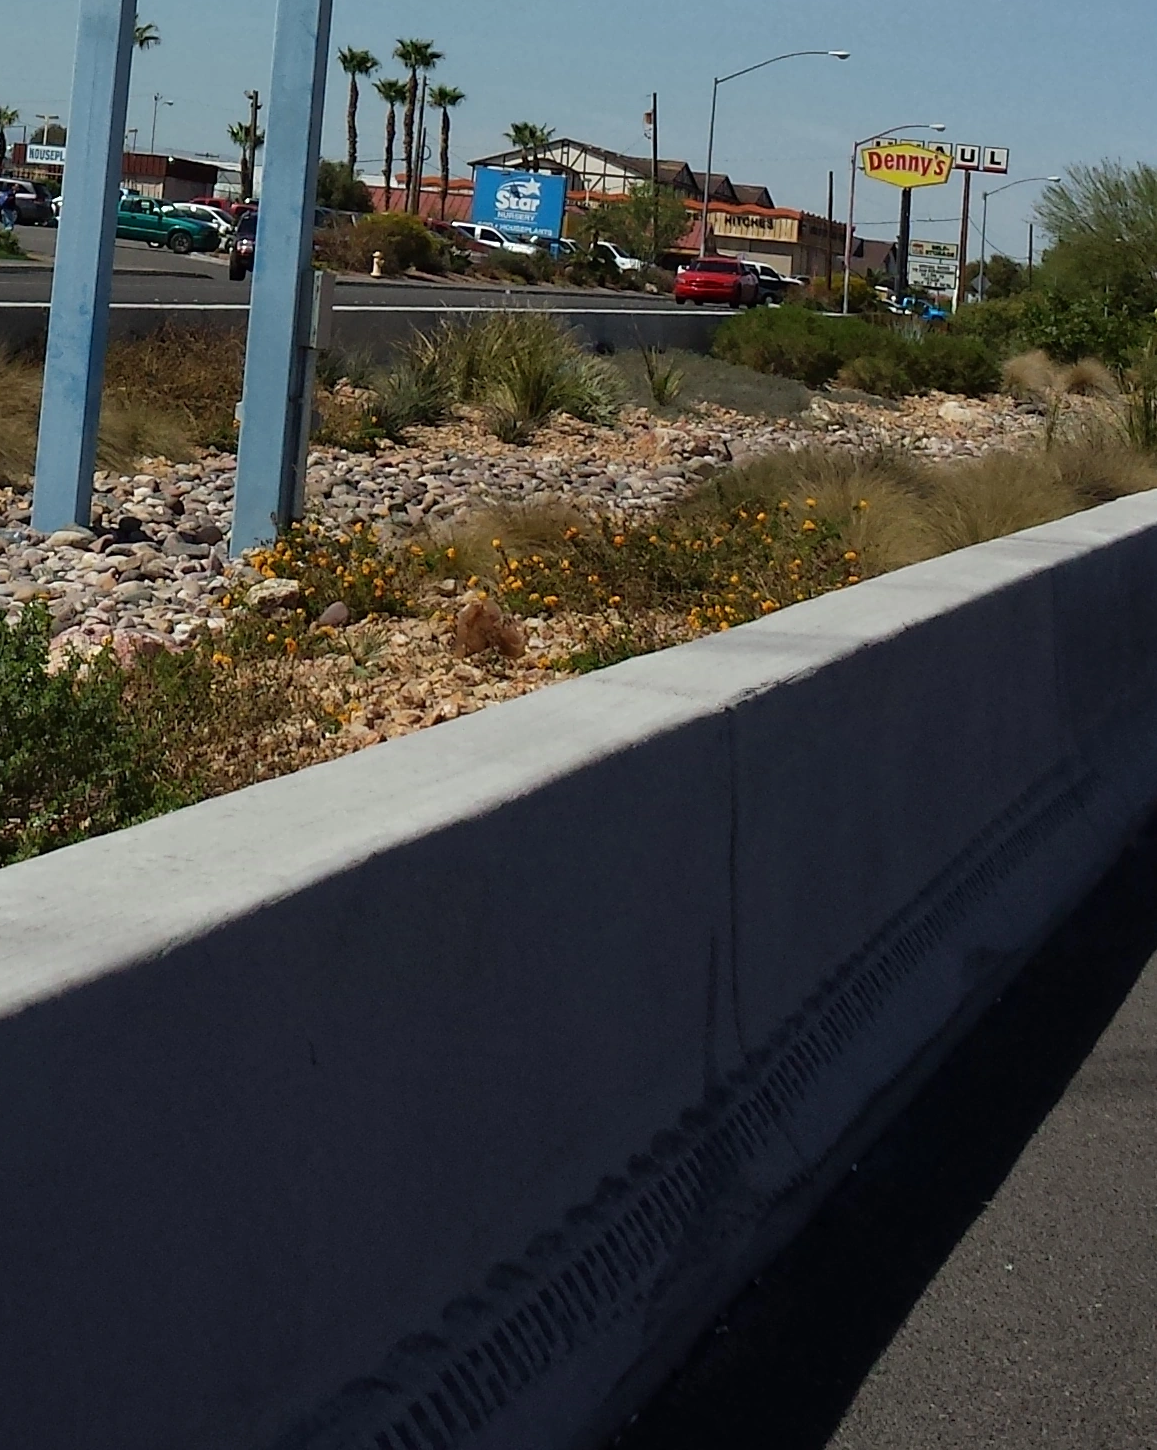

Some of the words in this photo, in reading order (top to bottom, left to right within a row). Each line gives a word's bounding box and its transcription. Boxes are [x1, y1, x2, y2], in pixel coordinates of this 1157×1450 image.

[867, 151, 946, 177] Denny's
[495, 189, 540, 212] Star
[497, 211, 536, 222] NURSERY
